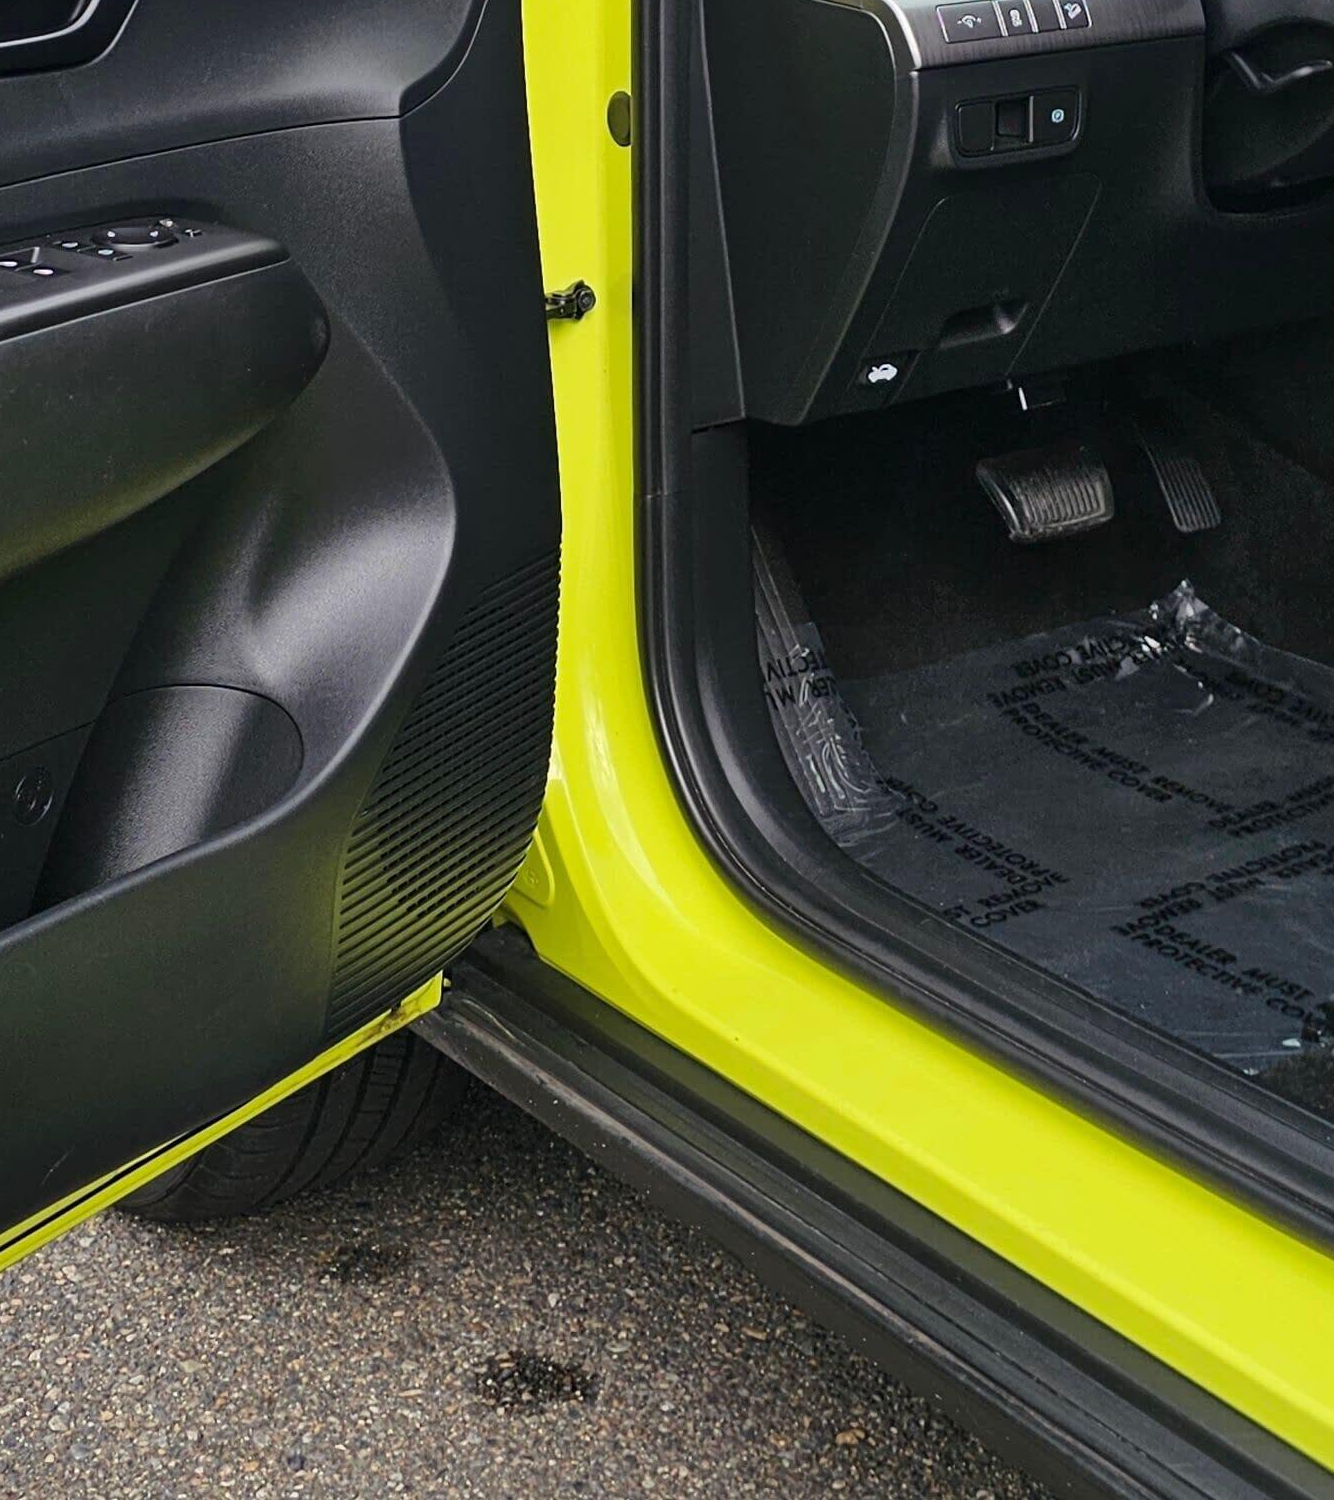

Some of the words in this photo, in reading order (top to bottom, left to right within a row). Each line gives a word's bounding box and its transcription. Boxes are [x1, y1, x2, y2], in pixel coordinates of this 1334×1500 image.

[1003, 707, 1109, 771] PROTECTIVE
[1108, 770, 1173, 803] COVER
[1022, 701, 1089, 744] DEALER
[1093, 747, 1149, 774] MUST
[1152, 775, 1234, 813] REMOVE
[955, 843, 1026, 885] DEALER
[1131, 932, 1263, 995] PROTECTIVE
[1154, 923, 1237, 964] DEALER
[1242, 968, 1315, 1000] MUST
